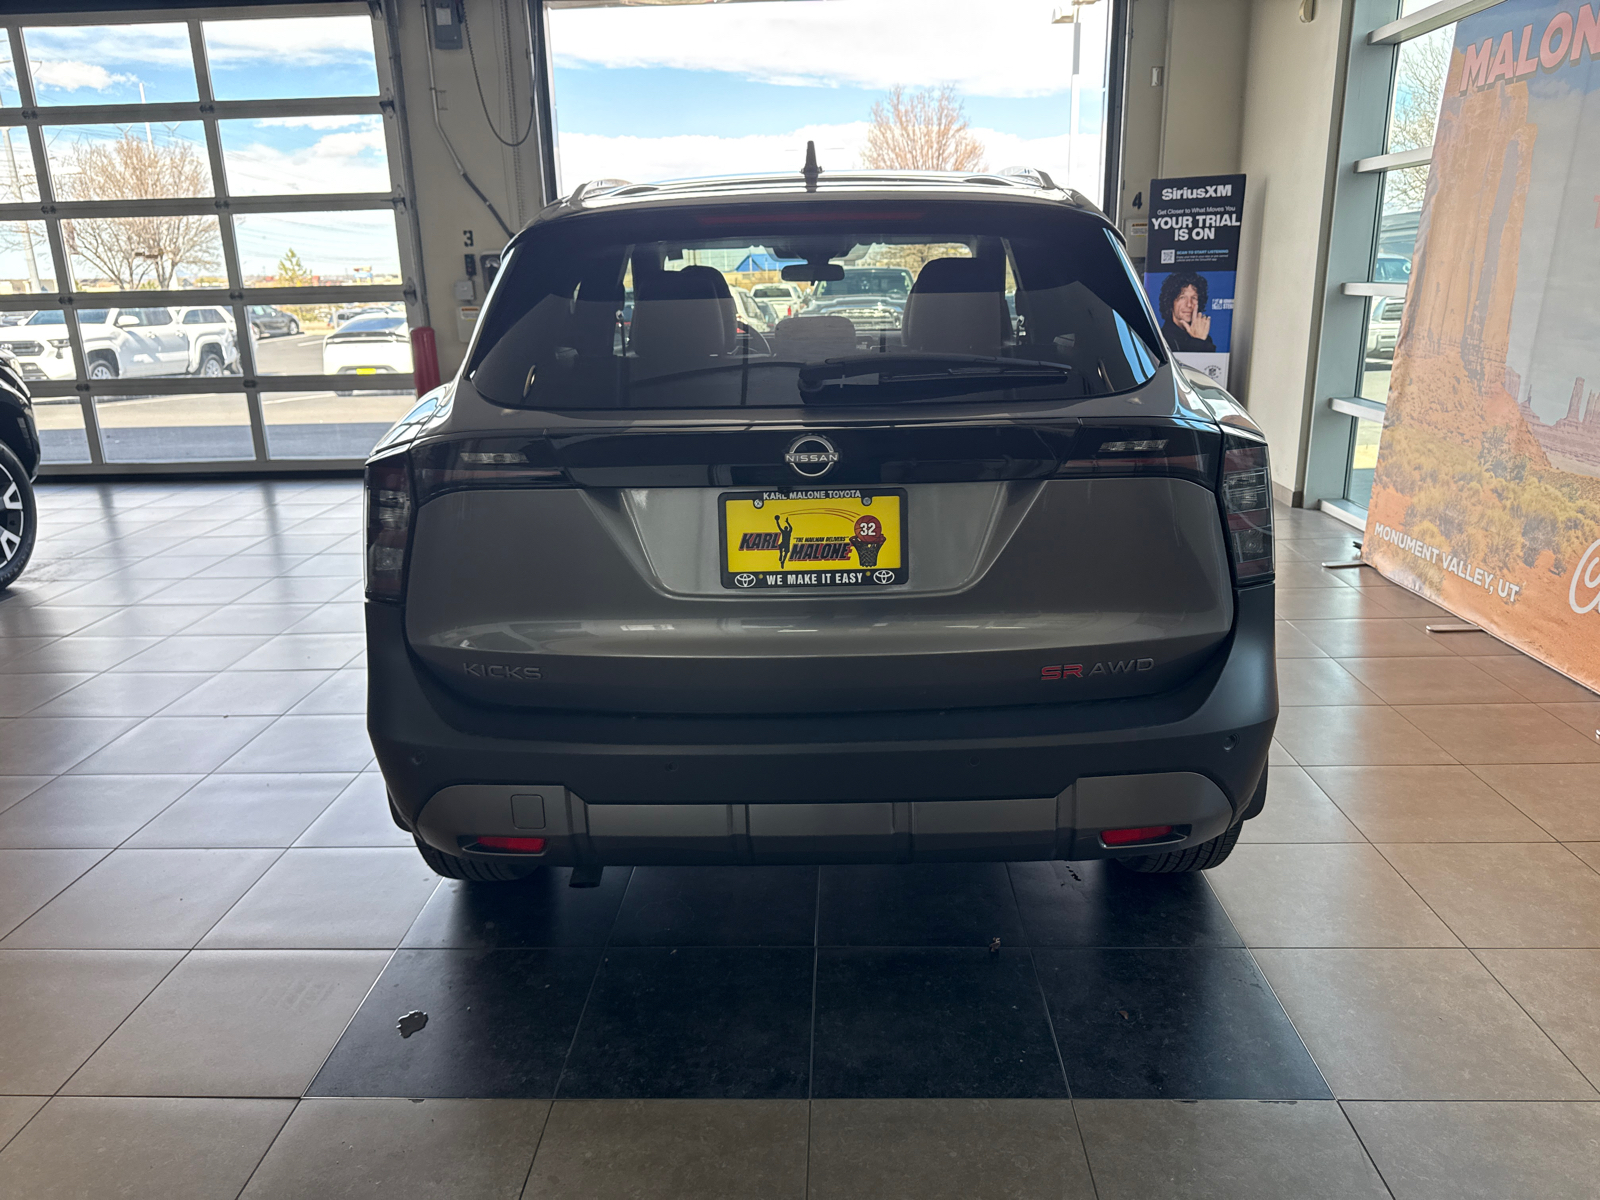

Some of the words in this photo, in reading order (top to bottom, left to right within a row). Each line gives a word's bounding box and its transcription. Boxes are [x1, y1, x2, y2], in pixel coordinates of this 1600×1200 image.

[1132, 191, 1143, 210] 4
[1161, 184, 1232, 201] SiriusXM
[1151, 215, 1193, 230] YOUR
[1196, 213, 1241, 228] TRIAL
[463, 230, 474, 247] 3
[1174, 228, 1189, 241] IS
[1191, 227, 1215, 241] ON
[785, 453, 839, 462] NISSAN
[763, 491, 787, 500] KARL
[789, 491, 826, 500] MALONE
[828, 490, 861, 498] TOYOTA
[860, 522, 876, 536] 32
[738, 532, 782, 551] KARL
[788, 543, 853, 562] MALONE
[1374, 522, 1440, 565] MONUMENT
[1442, 555, 1495, 595] VALLEY,
[1499, 579, 1520, 603] UT
[766, 574, 783, 585] WE
[787, 573, 818, 585] MAKE
[822, 573, 832, 584] IT
[835, 572, 863, 584] EASY
[463, 662, 542, 680] KICKS
[1041, 664, 1084, 681] SR
[1088, 657, 1155, 676] AWD
